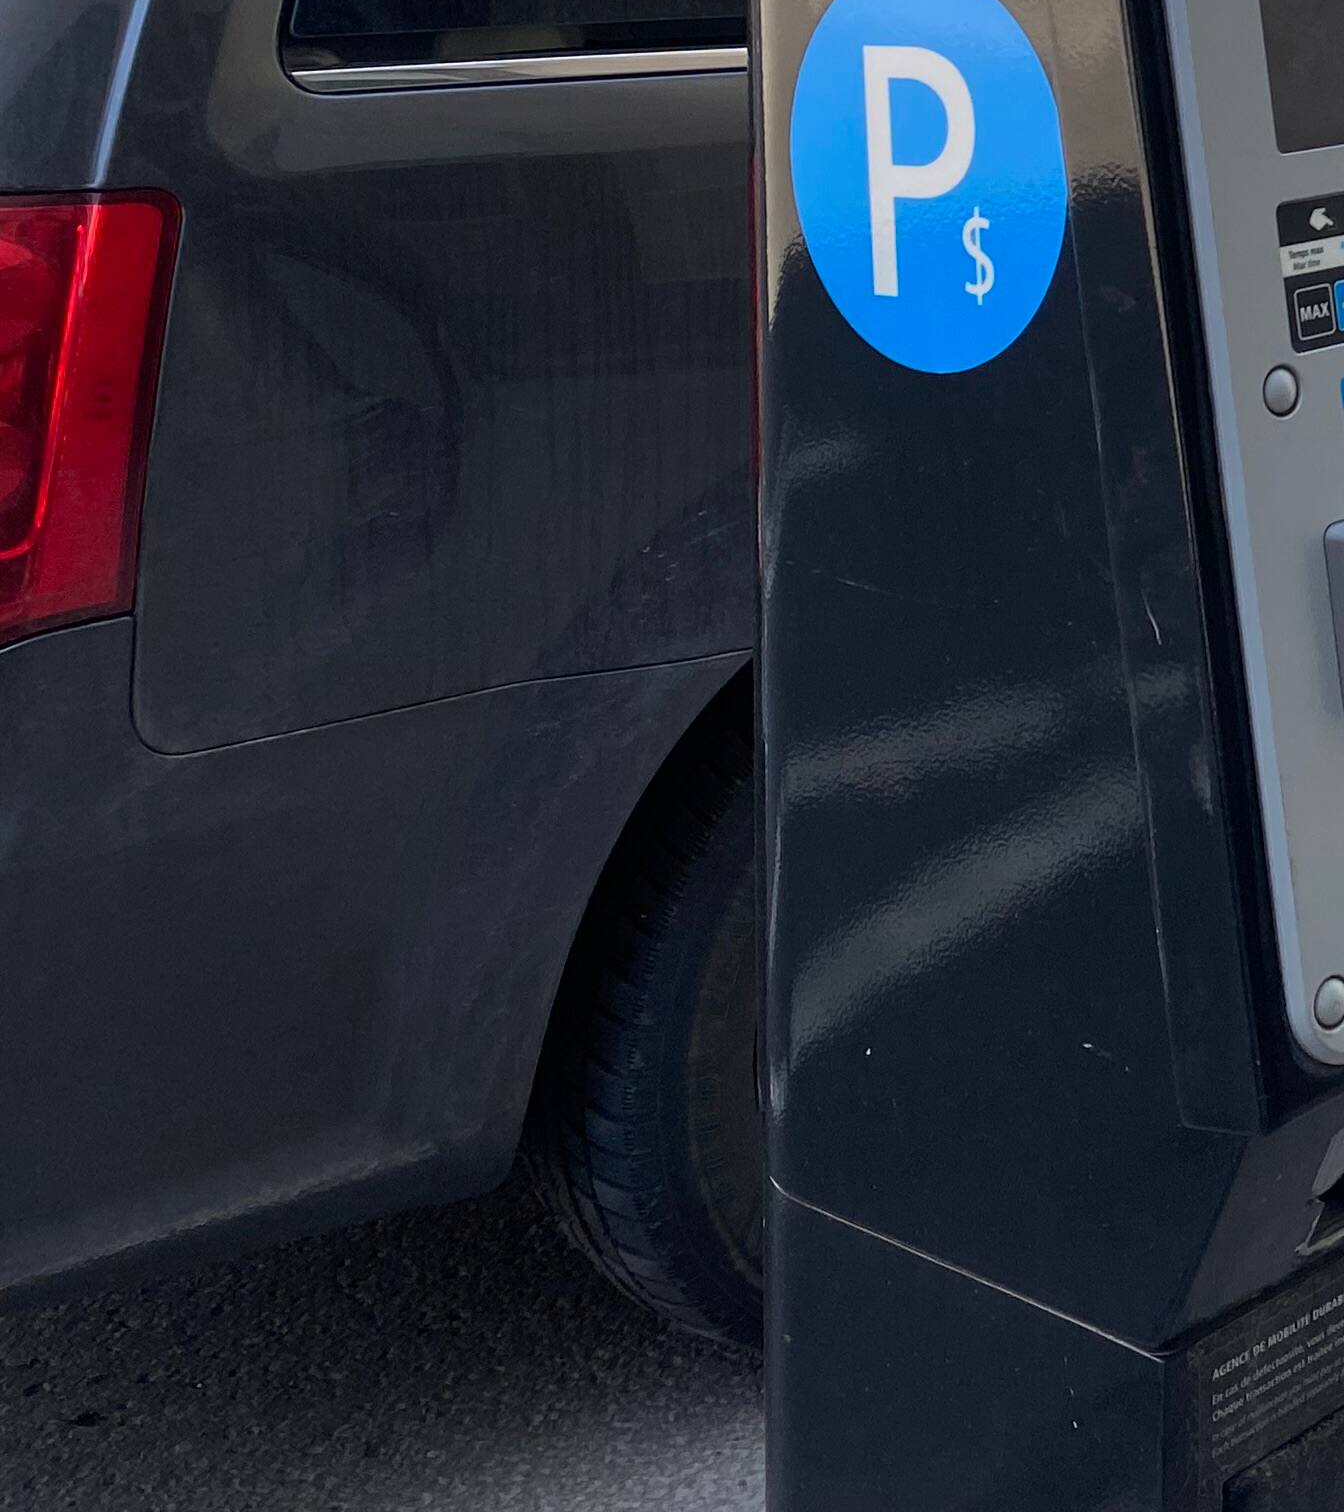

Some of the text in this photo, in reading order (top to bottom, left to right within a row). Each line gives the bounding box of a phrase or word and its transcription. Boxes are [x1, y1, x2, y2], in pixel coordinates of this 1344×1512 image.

[1300, 302, 1330, 322] MAX
[1212, 1349, 1250, 1382] AGENCE
[1253, 1340, 1266, 1358] DE
[1267, 1313, 1312, 1349] MOBILITÉ
